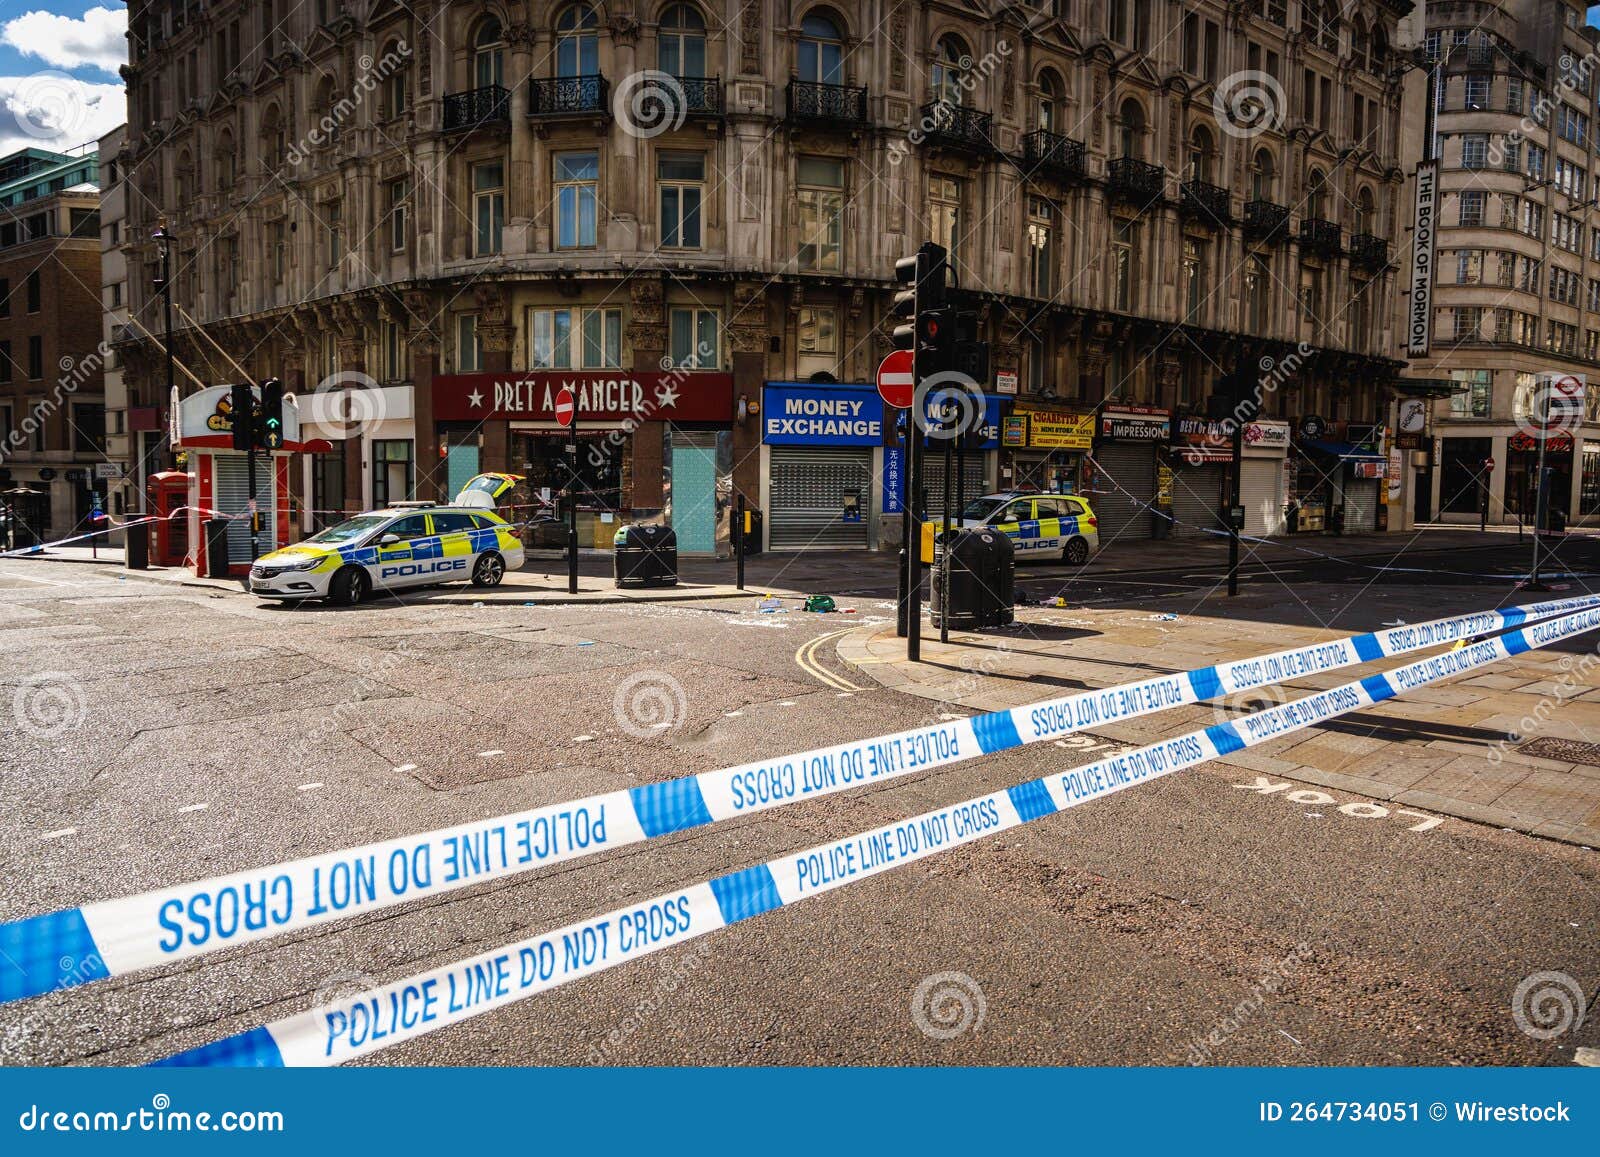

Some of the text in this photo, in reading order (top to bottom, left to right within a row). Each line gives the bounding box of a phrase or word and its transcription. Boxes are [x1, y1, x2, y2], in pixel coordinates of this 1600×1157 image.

[1413, 173, 1432, 347] THE BOOK OF MORMON
[494, 380, 535, 411] PRET
[542, 380, 554, 411] A
[785, 399, 863, 418] MONEY
[1033, 412, 1079, 425] CIGARETTES
[767, 418, 881, 437] EXCHANGE
[1179, 420, 1198, 434] BEST
[1013, 539, 1059, 550] OLICE
[382, 559, 466, 579] POLICE
[1389, 615, 1495, 652] POLICE LINE DO NOT CROSS
[1533, 621, 1559, 644] POLICE
[1560, 616, 1576, 636] LINE
[1576, 613, 1587, 630] DO
[1231, 643, 1348, 689] POLICE LINE DO NOT CROSS
[1396, 641, 1498, 689] POLICE LINE DO NOT CROSS
[1031, 679, 1182, 737] POLICE LINE DO NOT CROSS
[1245, 686, 1360, 740] POLICE LINE DO NOT CROSS
[731, 727, 959, 810] POLICE LINE DO NOT CROSS
[1062, 766, 1101, 802] POLICE
[1104, 758, 1130, 788] LINE
[1132, 752, 1146, 779] DO
[1148, 746, 1168, 774] NOT
[1170, 736, 1203, 766] CROSS
[1232, 776, 1446, 832] LOOK
[797, 800, 999, 891] POLICE LINE DO NOT CROSS
[158, 806, 607, 953] POLICE LINE DO NOT CROSS
[326, 896, 691, 1056] POLICE LINE DO NOT CROSS
